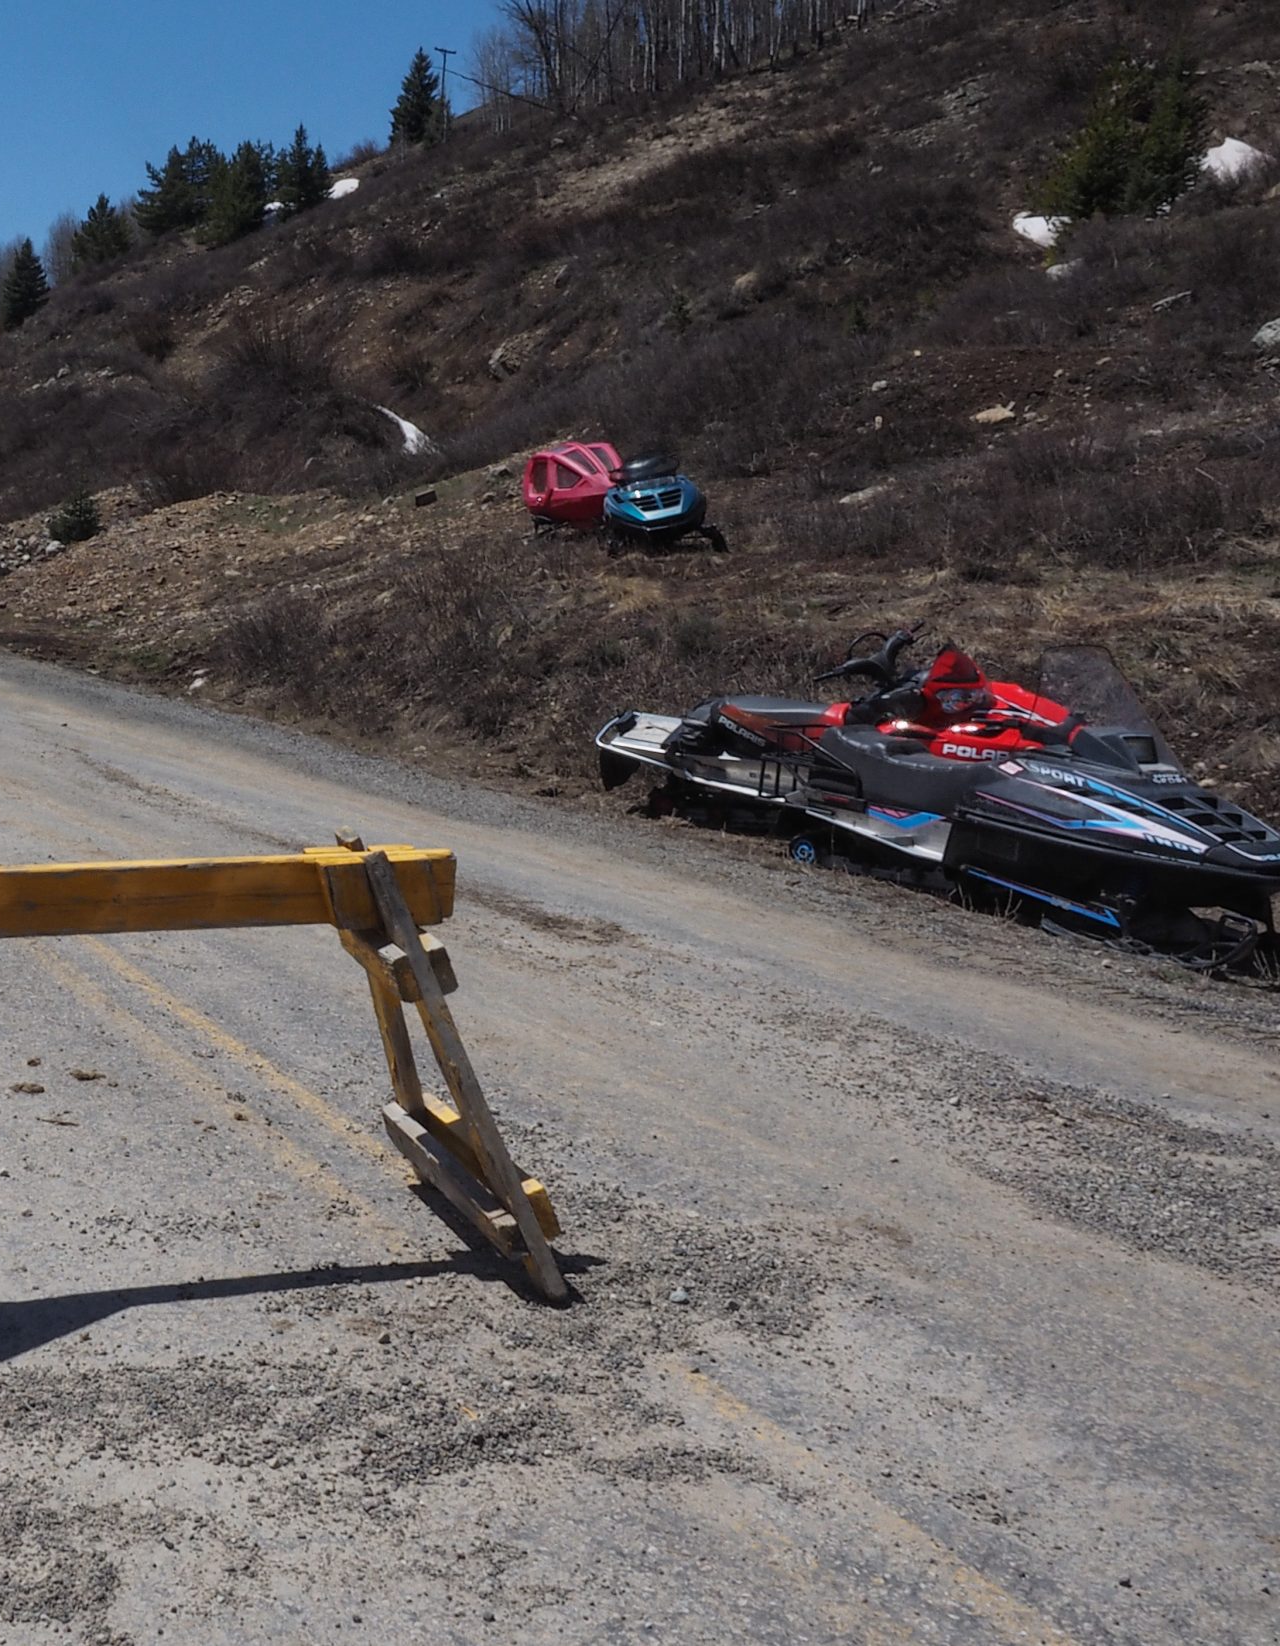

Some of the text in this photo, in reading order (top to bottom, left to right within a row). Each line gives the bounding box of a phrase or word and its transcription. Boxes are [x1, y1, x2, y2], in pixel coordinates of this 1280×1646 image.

[718, 715, 767, 747] POLARIS
[942, 743, 1010, 761] POLAR
[1028, 762, 1085, 788] SPORT
